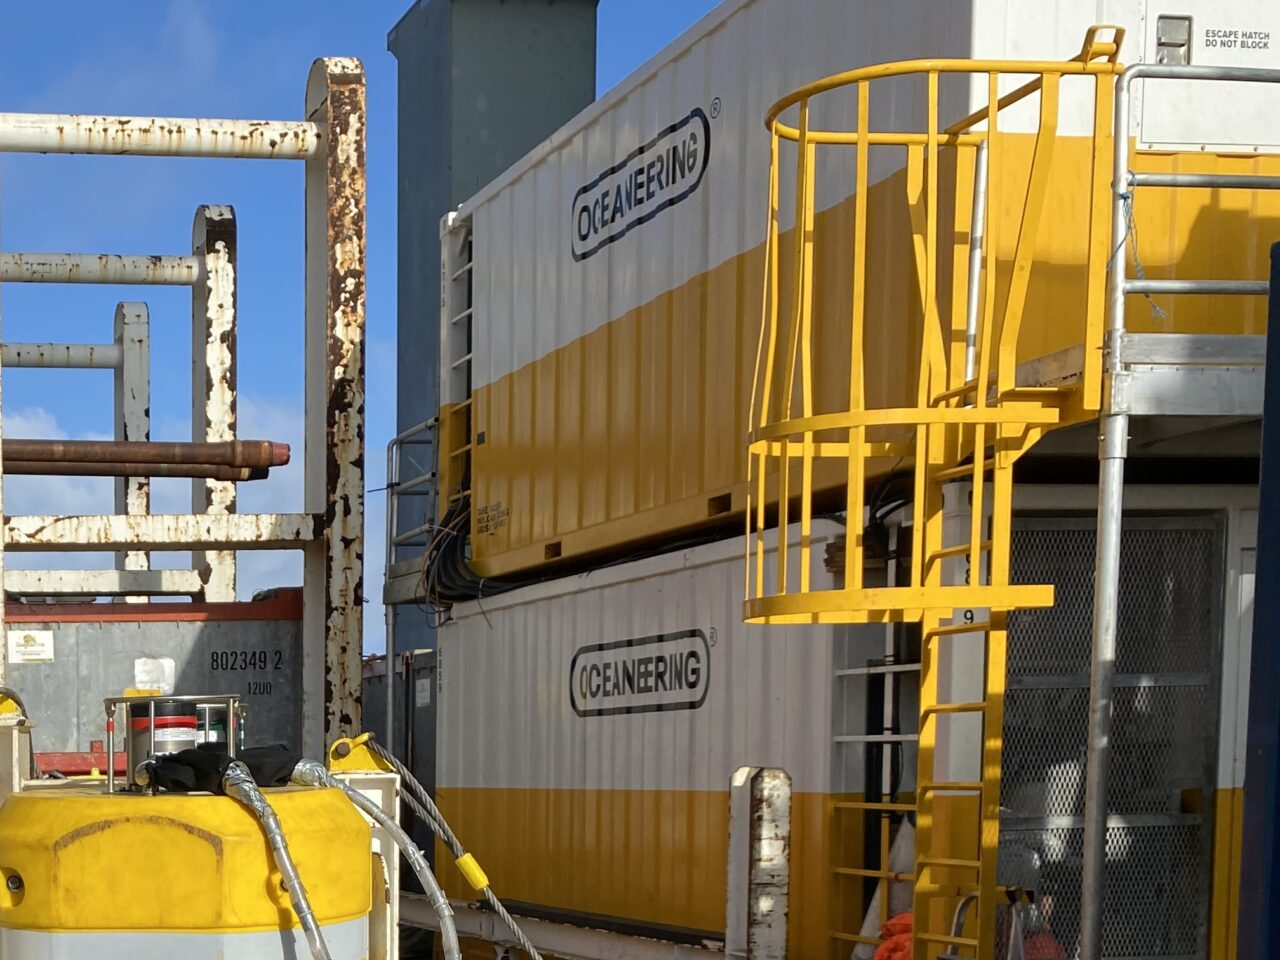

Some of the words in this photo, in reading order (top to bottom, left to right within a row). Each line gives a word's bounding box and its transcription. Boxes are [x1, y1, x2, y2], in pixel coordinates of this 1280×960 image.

[1205, 29, 1239, 39] ESCAPE
[1241, 31, 1270, 40] HATCH
[1205, 39, 1218, 48] DO
[1220, 40, 1237, 48] NOT
[1240, 41, 1269, 49] BLOCK
[577, 131, 699, 243] OCEANEERING
[210, 650, 268, 671] 802349
[273, 650, 283, 670] 2
[579, 650, 701, 699] OCEANEERING
